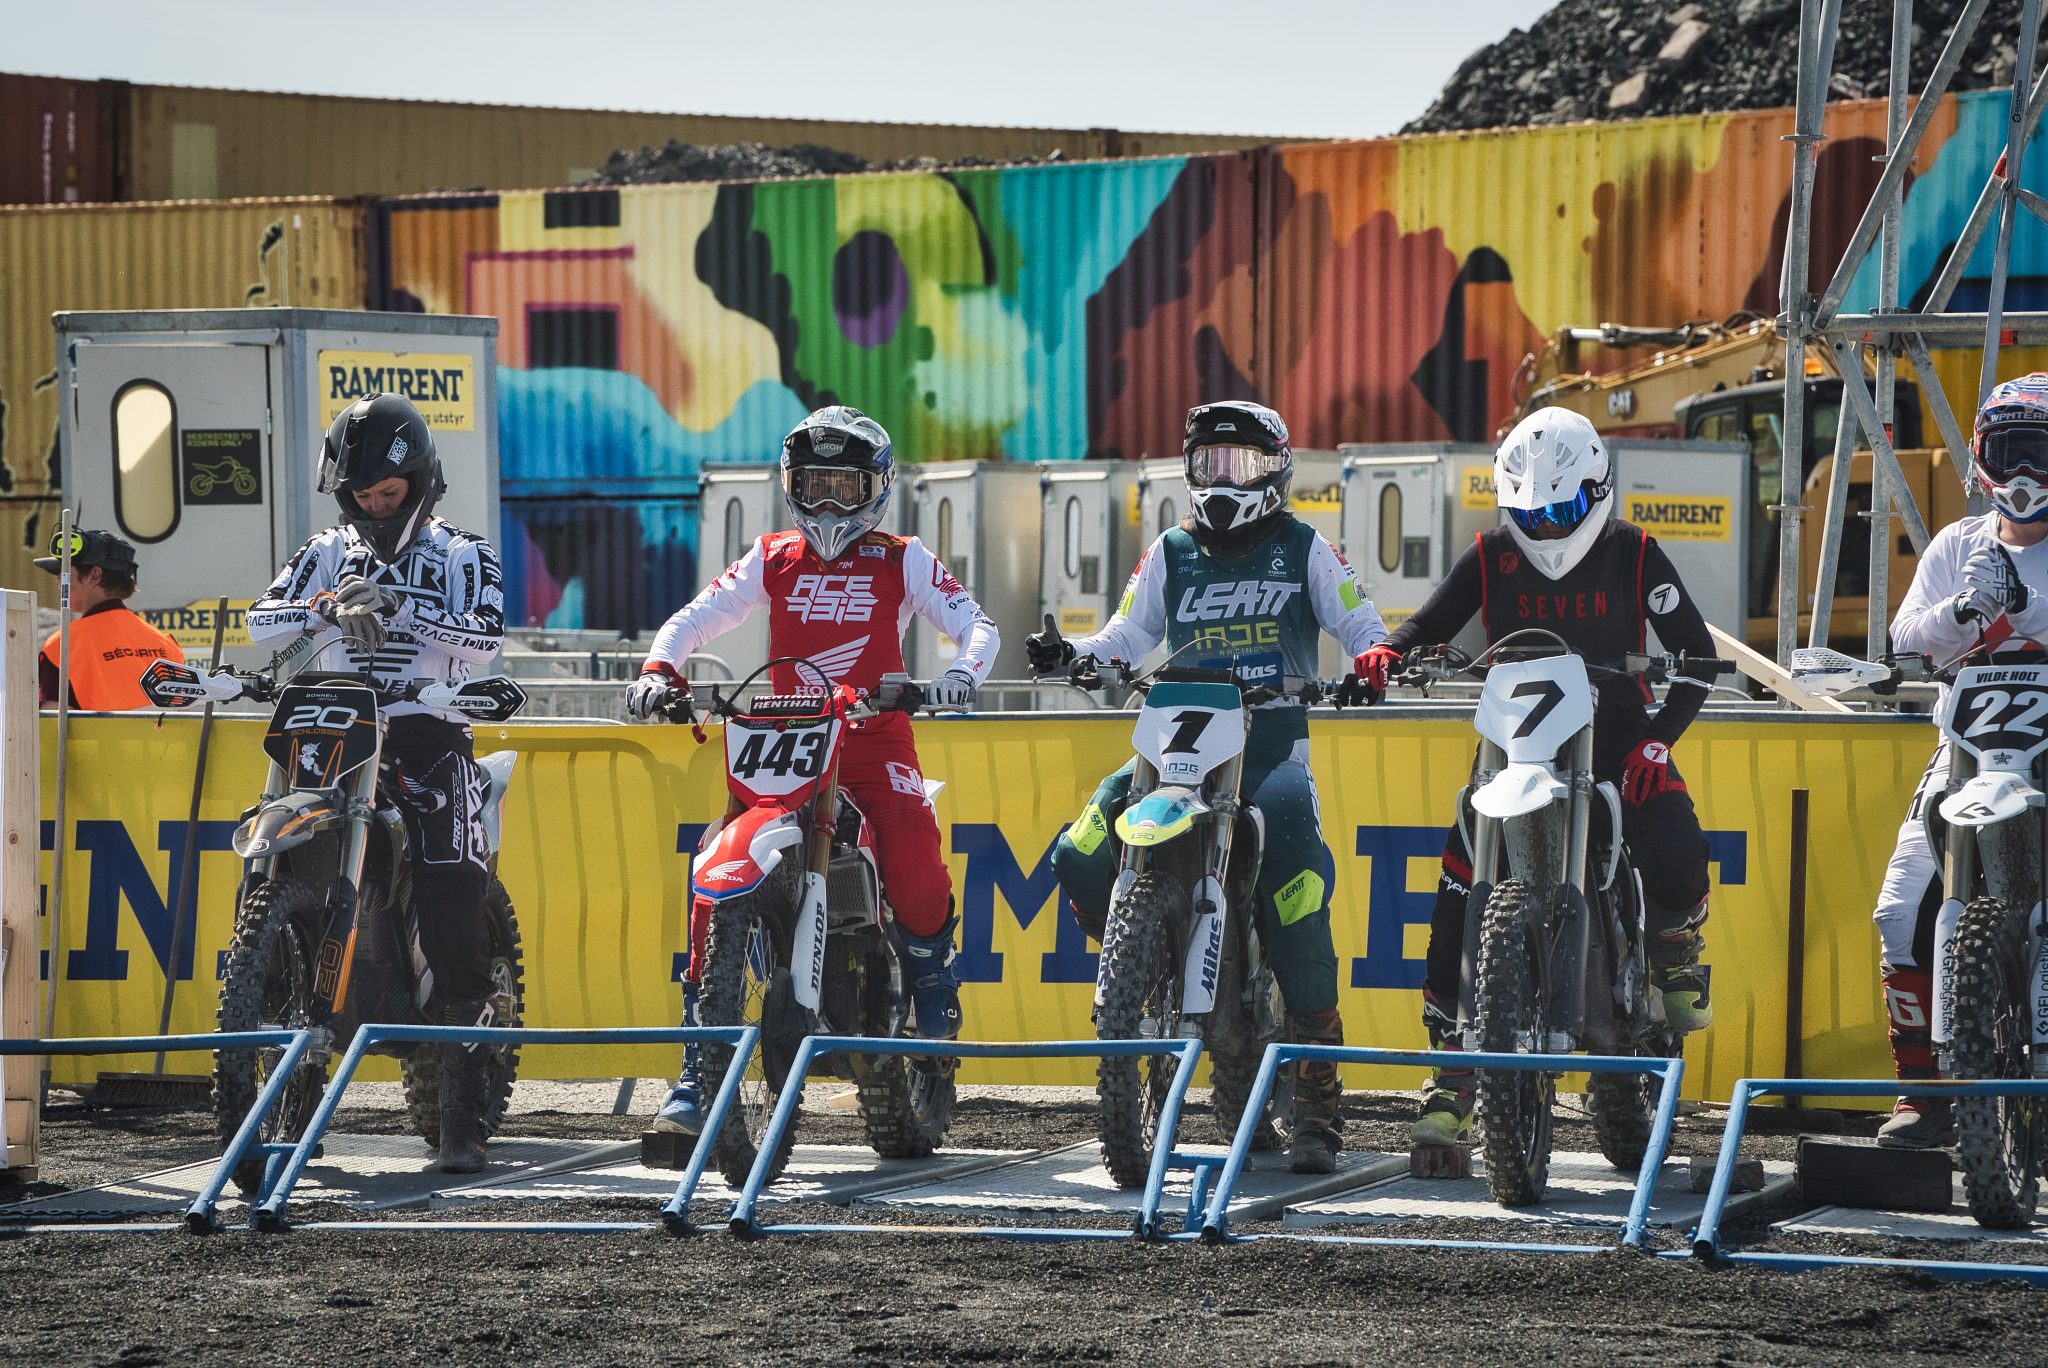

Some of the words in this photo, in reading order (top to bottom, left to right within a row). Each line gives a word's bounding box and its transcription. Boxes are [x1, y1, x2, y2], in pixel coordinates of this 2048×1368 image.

[329, 366, 464, 402] RAMIRENT
[433, 413, 465, 426] utstyr
[814, 442, 843, 453] AIROH
[1631, 502, 1725, 525] RAMIRENT
[1176, 580, 1303, 623] LEATT
[1519, 592, 1608, 619] SEVEN
[138, 608, 247, 630] MIRENT
[247, 614, 273, 627] RACE
[417, 622, 462, 646] RACE
[1235, 664, 1278, 681] itas
[1975, 671, 2009, 684] VILDE
[2009, 670, 2040, 682] HOLT
[158, 685, 207, 696] ACERBIS
[793, 685, 869, 697] HOA
[449, 699, 495, 708] ACERBIS
[753, 699, 820, 710] RENTHAL
[1510, 680, 1566, 740] 7
[1963, 689, 2048, 739] 22
[283, 705, 359, 730] 20
[290, 728, 348, 737] SCHLOSSER
[1161, 710, 1216, 756] 1
[732, 731, 827, 780] 443
[703, 874, 745, 883] HONDA
[1281, 876, 1306, 902] LEATT
[811, 901, 827, 990] DUNLOP
[1201, 917, 1223, 1001] Mitas
